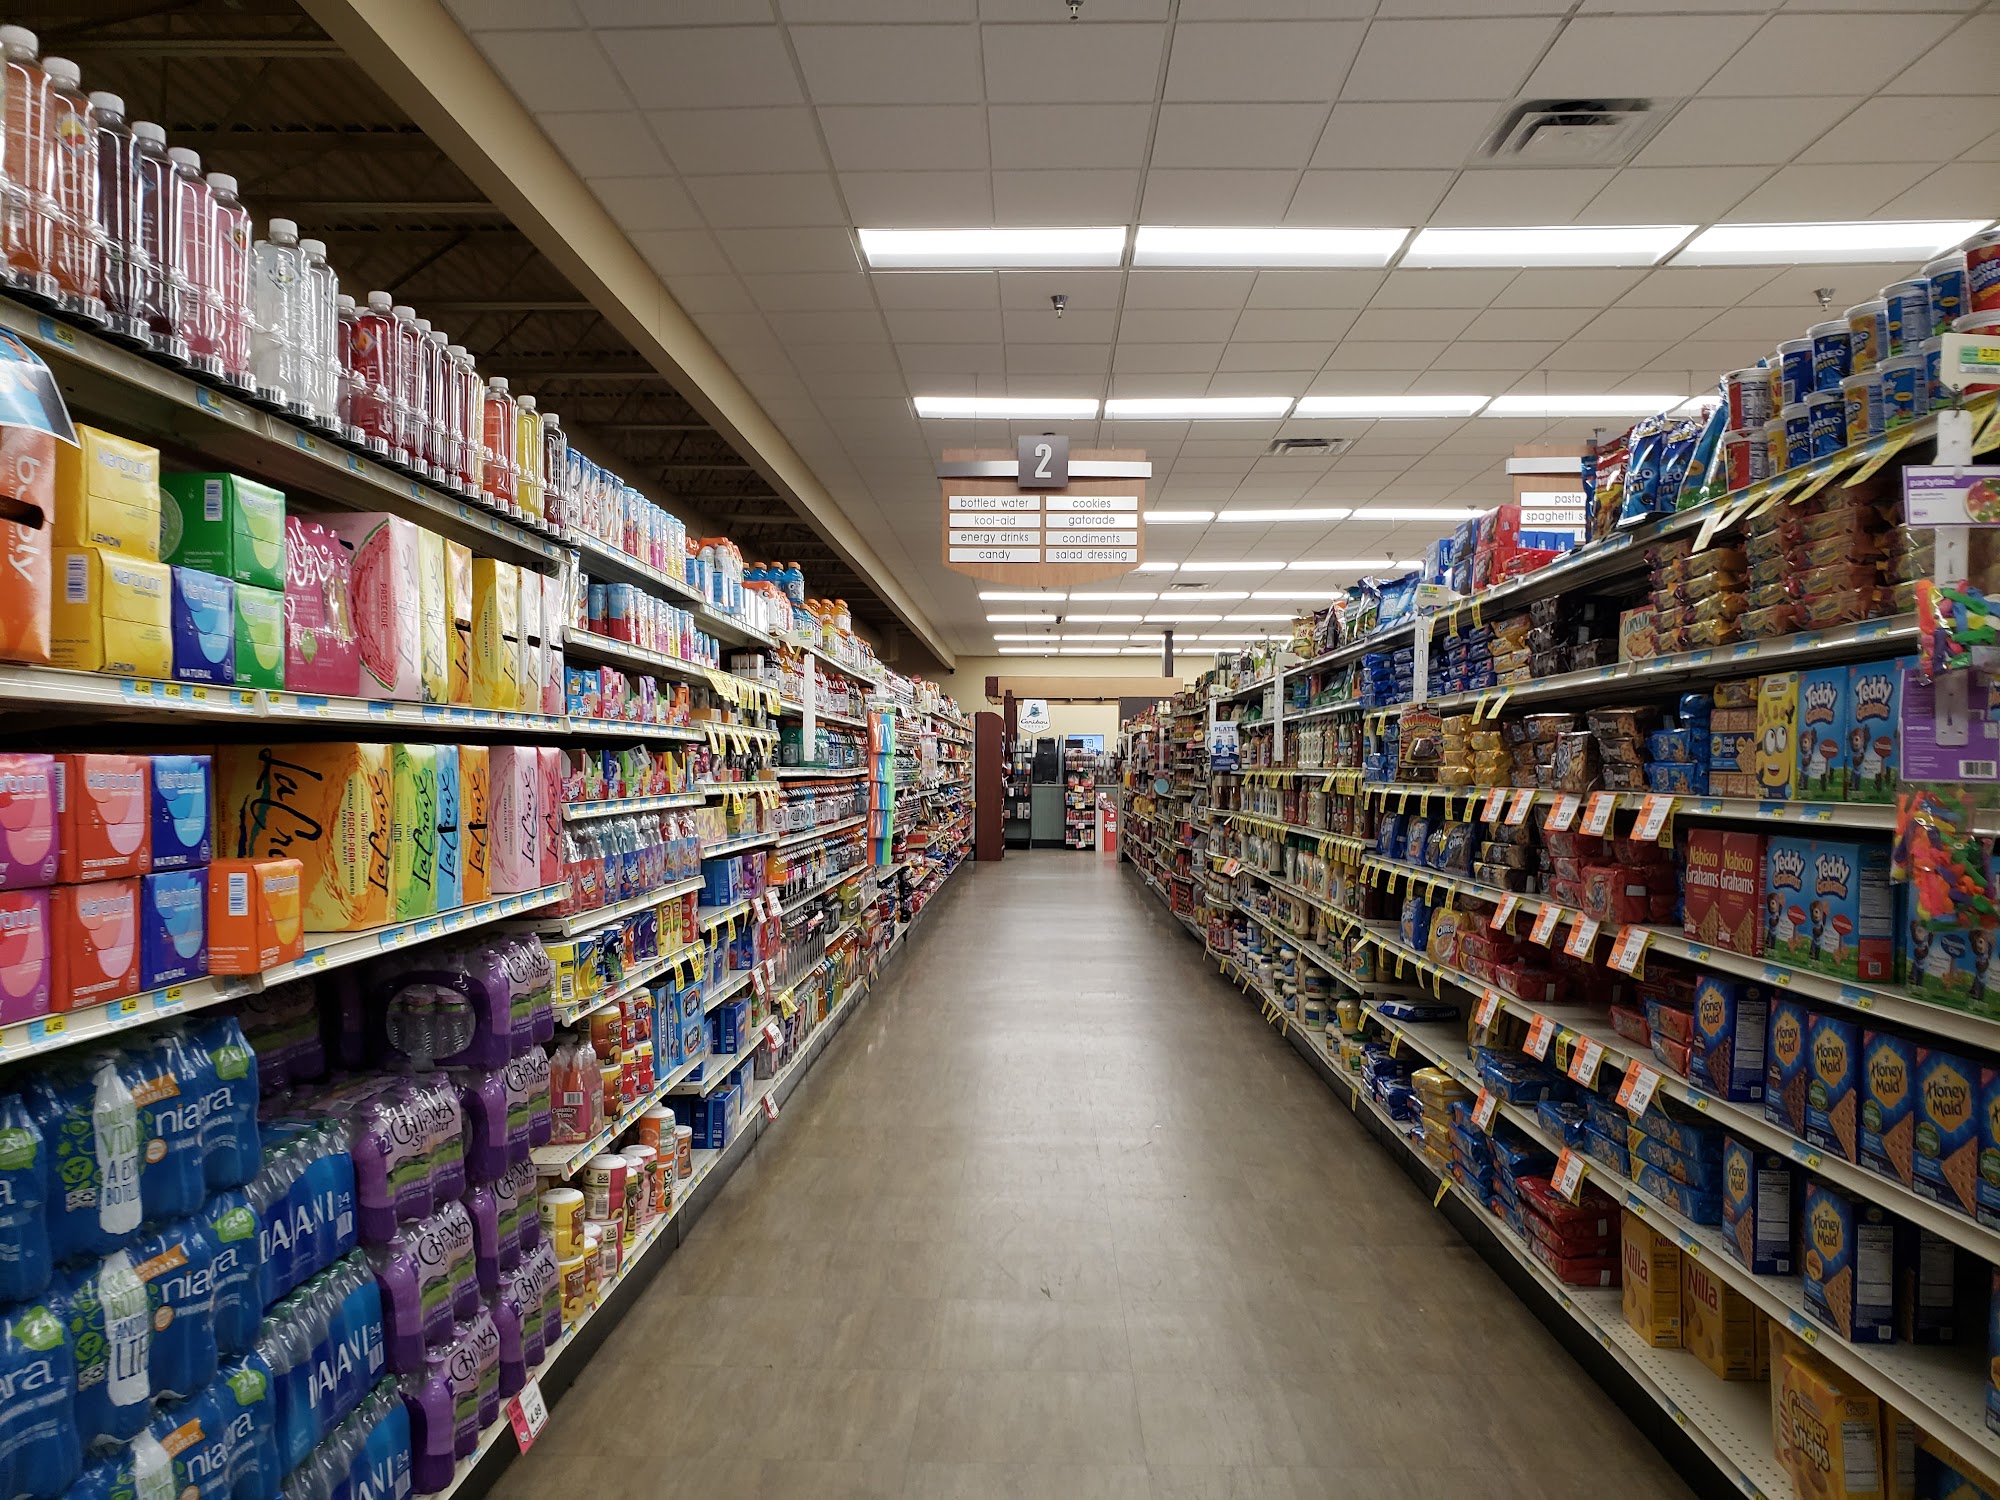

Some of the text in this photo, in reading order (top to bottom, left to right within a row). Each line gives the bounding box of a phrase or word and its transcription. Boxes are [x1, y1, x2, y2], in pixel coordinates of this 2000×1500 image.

[1034, 443, 1052, 478] 2
[960, 498, 1029, 508] bottled water
[1072, 499, 1111, 509] cookies
[1554, 494, 1582, 505] pasta
[9, 455, 41, 582] bly
[974, 516, 1016, 525] kool-aid
[1068, 516, 1115, 526] gatorade
[1526, 510, 1574, 524] spaghetti
[91, 533, 122, 548] LEMON
[961, 532, 1029, 543] energy drinks
[1062, 534, 1120, 543] condiments
[979, 550, 1011, 561] candy
[1056, 550, 1128, 562] salad dressing
[380, 583, 388, 629] PASTEQUE
[107, 661, 137, 672] LEMON
[179, 667, 213, 680] NATURAL
[1805, 681, 1837, 707] Teddy
[1855, 674, 1892, 703] Teddy
[394, 823, 402, 843] LIME
[81, 856, 130, 869] STRAWBERRY
[154, 855, 188, 868] NATURAL
[1689, 845, 1718, 867] Nabisco
[1723, 849, 1753, 873] Nabisco
[1773, 847, 1805, 878] Teddy
[1815, 852, 1850, 883] Teddy
[1686, 864, 1719, 890] Grahams
[1720, 872, 1754, 896] Grahams
[1436, 925, 1455, 938] OREO
[153, 967, 187, 984] NATURAL
[73, 979, 120, 996] STRAWBERRY
[1700, 998, 1722, 1014] Honey
[1702, 1010, 1720, 1025] Maid
[1776, 1025, 1799, 1043] Honey
[1778, 1039, 1796, 1053] Maid
[1815, 1042, 1844, 1062] Honey
[1820, 1058, 1842, 1074] Maid
[1870, 1061, 1903, 1081] Honey
[1875, 1076, 1900, 1095] Maid
[1926, 1082, 1967, 1104] Honey
[551, 1106, 577, 1115] Country
[1932, 1098, 1963, 1118] Maid
[1728, 1163, 1747, 1181] Honey
[664, 1169, 672, 1197] TANG
[1730, 1176, 1745, 1192] Maid
[1814, 1212, 1842, 1236] Honey
[1817, 1229, 1838, 1248] Maid
[1624, 1238, 1649, 1285] Nilla
[1687, 1262, 1719, 1312] Nilla
[1788, 1388, 1829, 1444] Ginger
[1791, 1421, 1831, 1473] Snaps
